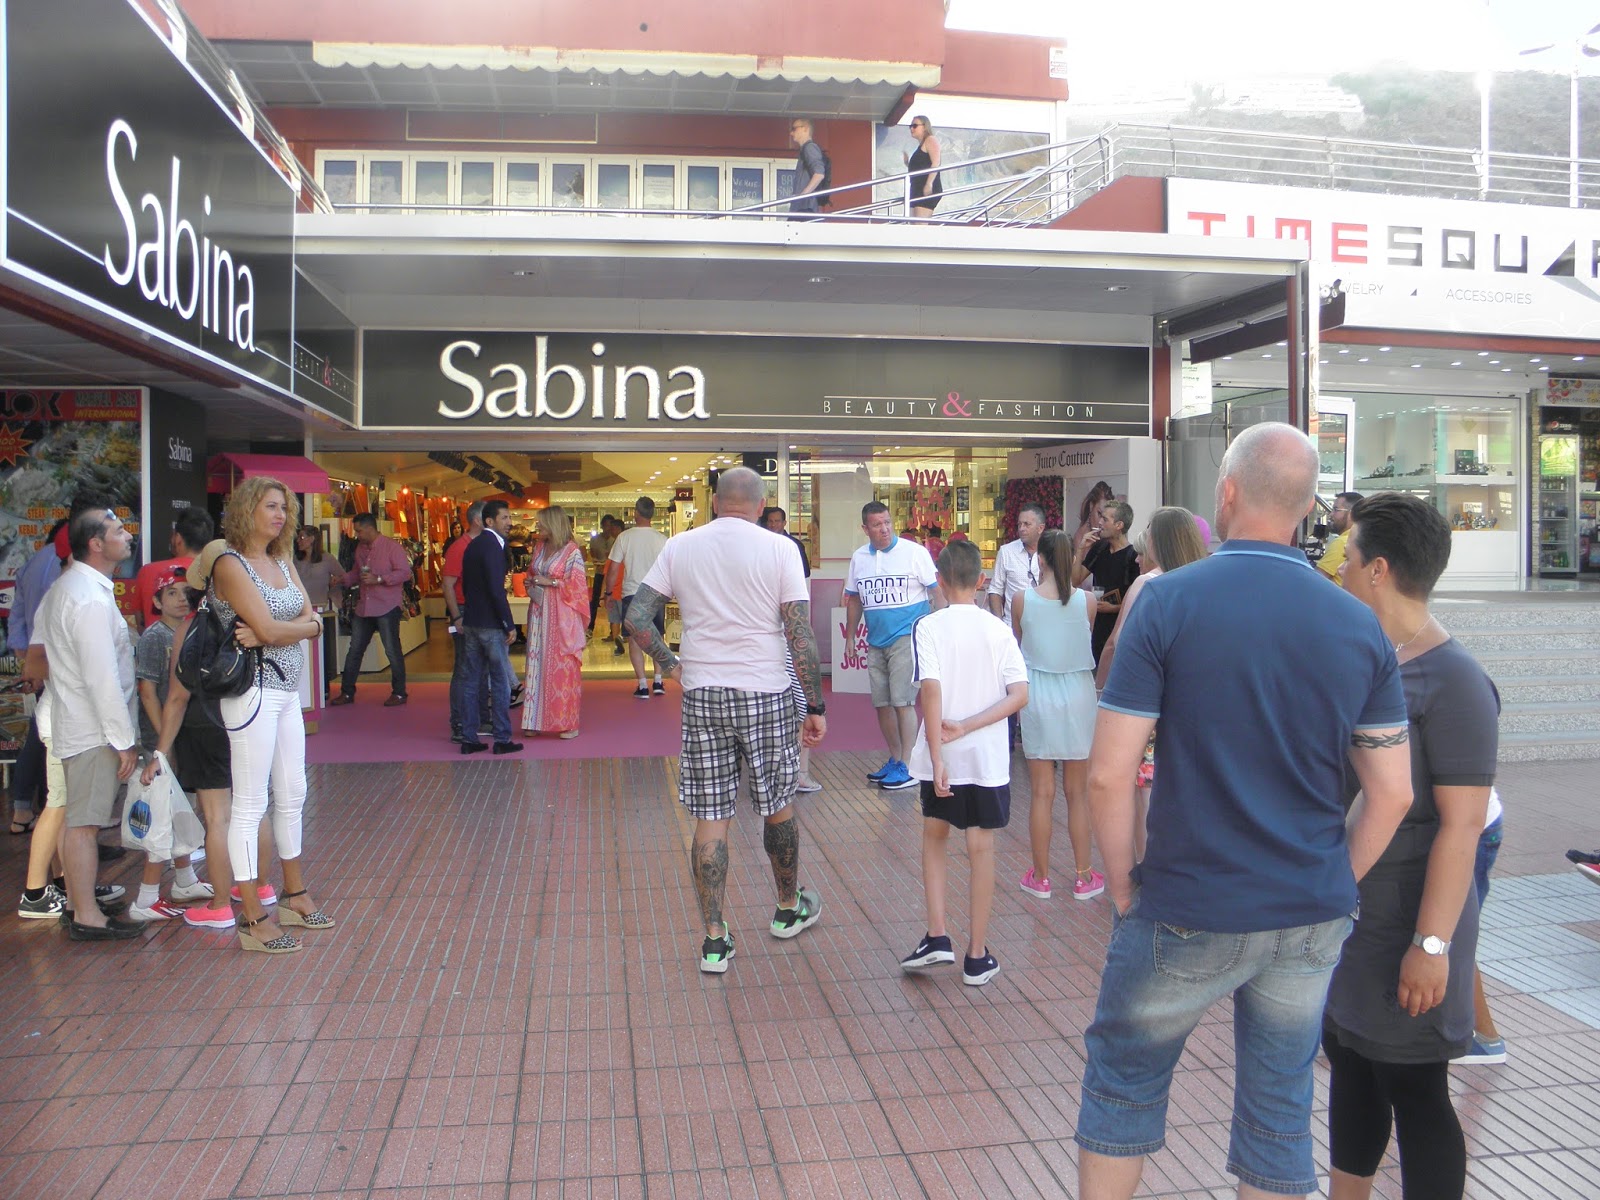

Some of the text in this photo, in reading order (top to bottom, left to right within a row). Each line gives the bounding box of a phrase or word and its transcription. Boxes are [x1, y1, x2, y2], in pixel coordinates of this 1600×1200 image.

[104, 119, 255, 352] Sabina
[1446, 289, 1532, 305] ACCESSORIES
[437, 335, 711, 419] Sabina
[74, 410, 137, 419] INTERNATIONAL
[822, 391, 1094, 417] BEAUTY & FASHION
[169, 437, 193, 463] Sabina
[1034, 450, 1095, 472] Juicy Couture
[906, 468, 949, 493] VIVA
[917, 490, 943, 508] LA
[907, 506, 951, 529] JUICY
[18, 524, 38, 536] KEBAB
[841, 652, 868, 670] JUIC
